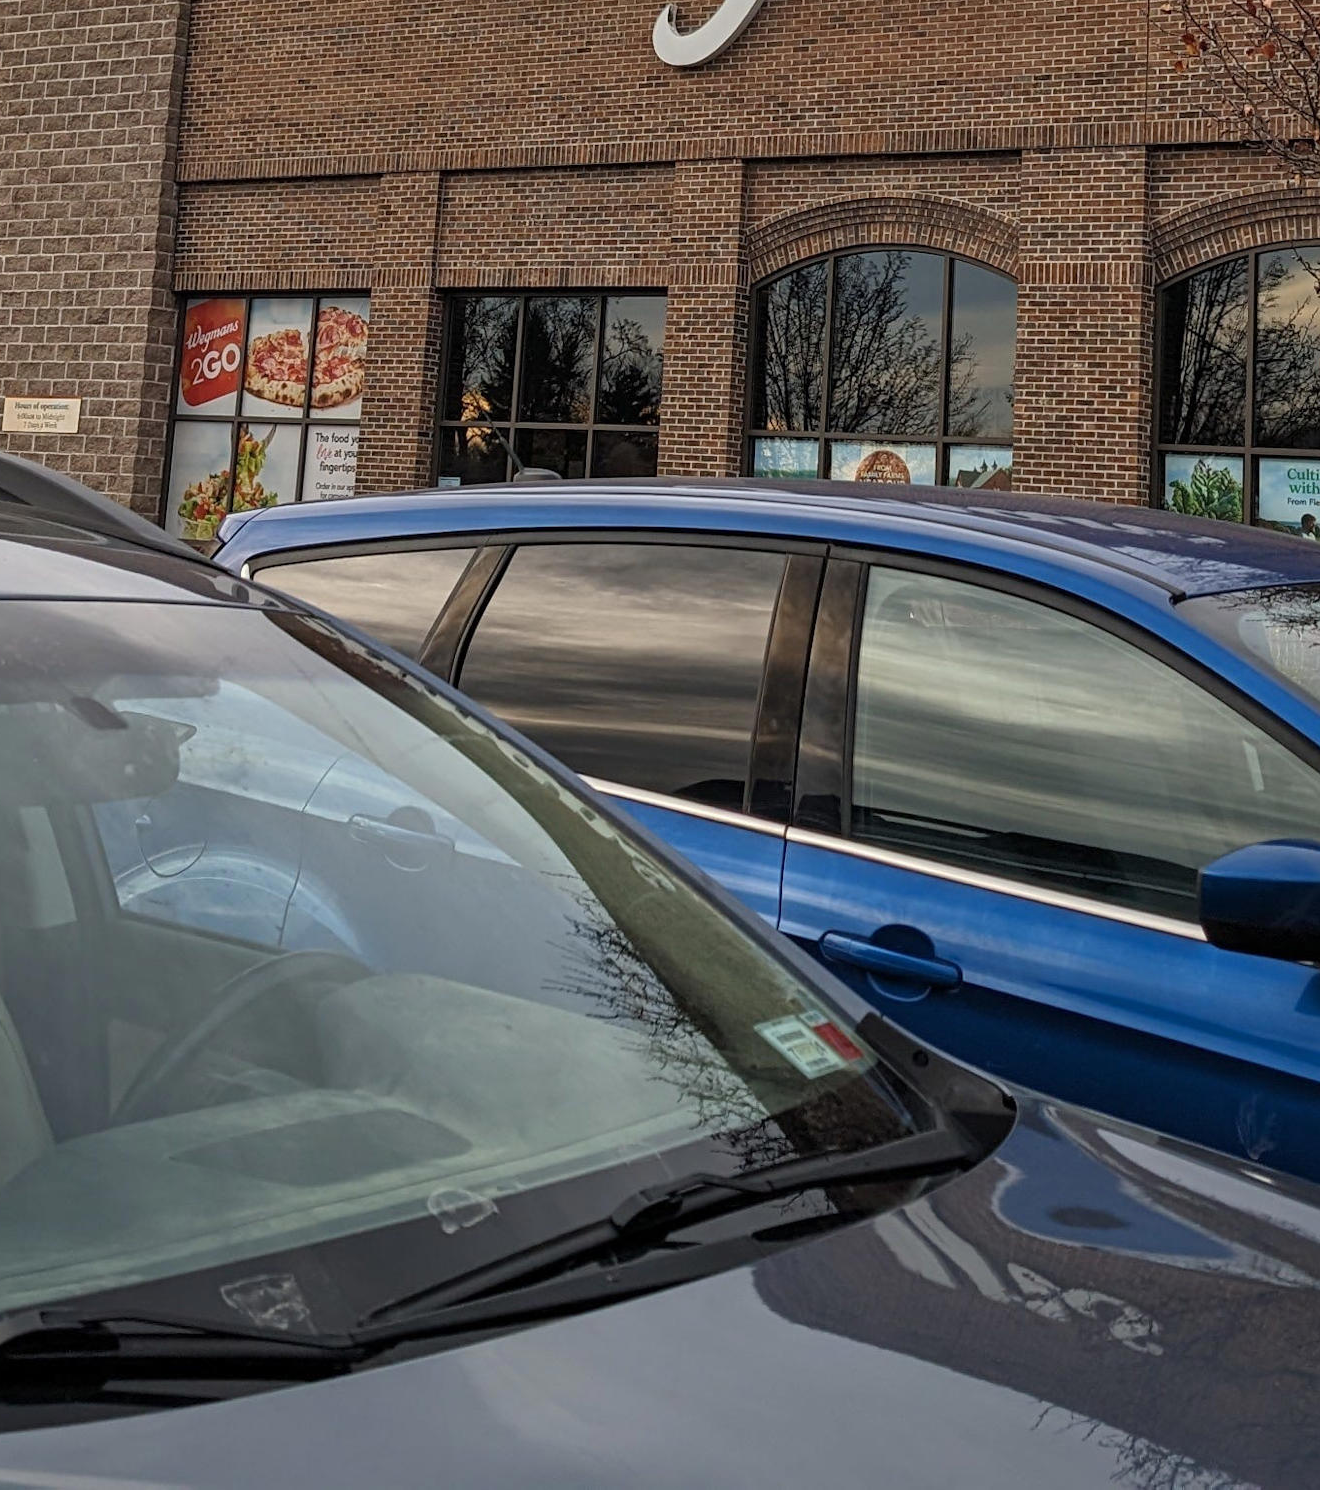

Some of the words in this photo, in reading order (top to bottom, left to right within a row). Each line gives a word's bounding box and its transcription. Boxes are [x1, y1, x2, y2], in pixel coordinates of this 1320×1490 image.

[186, 320, 239, 352] Wegmans
[191, 343, 240, 385] 2GO
[316, 432, 330, 443] The
[331, 432, 350, 443] food
[351, 436, 360, 446] yo
[334, 449, 342, 458] at
[320, 461, 356, 475] fingertips
[1289, 482, 1320, 495] with
[1287, 497, 1307, 506] From
